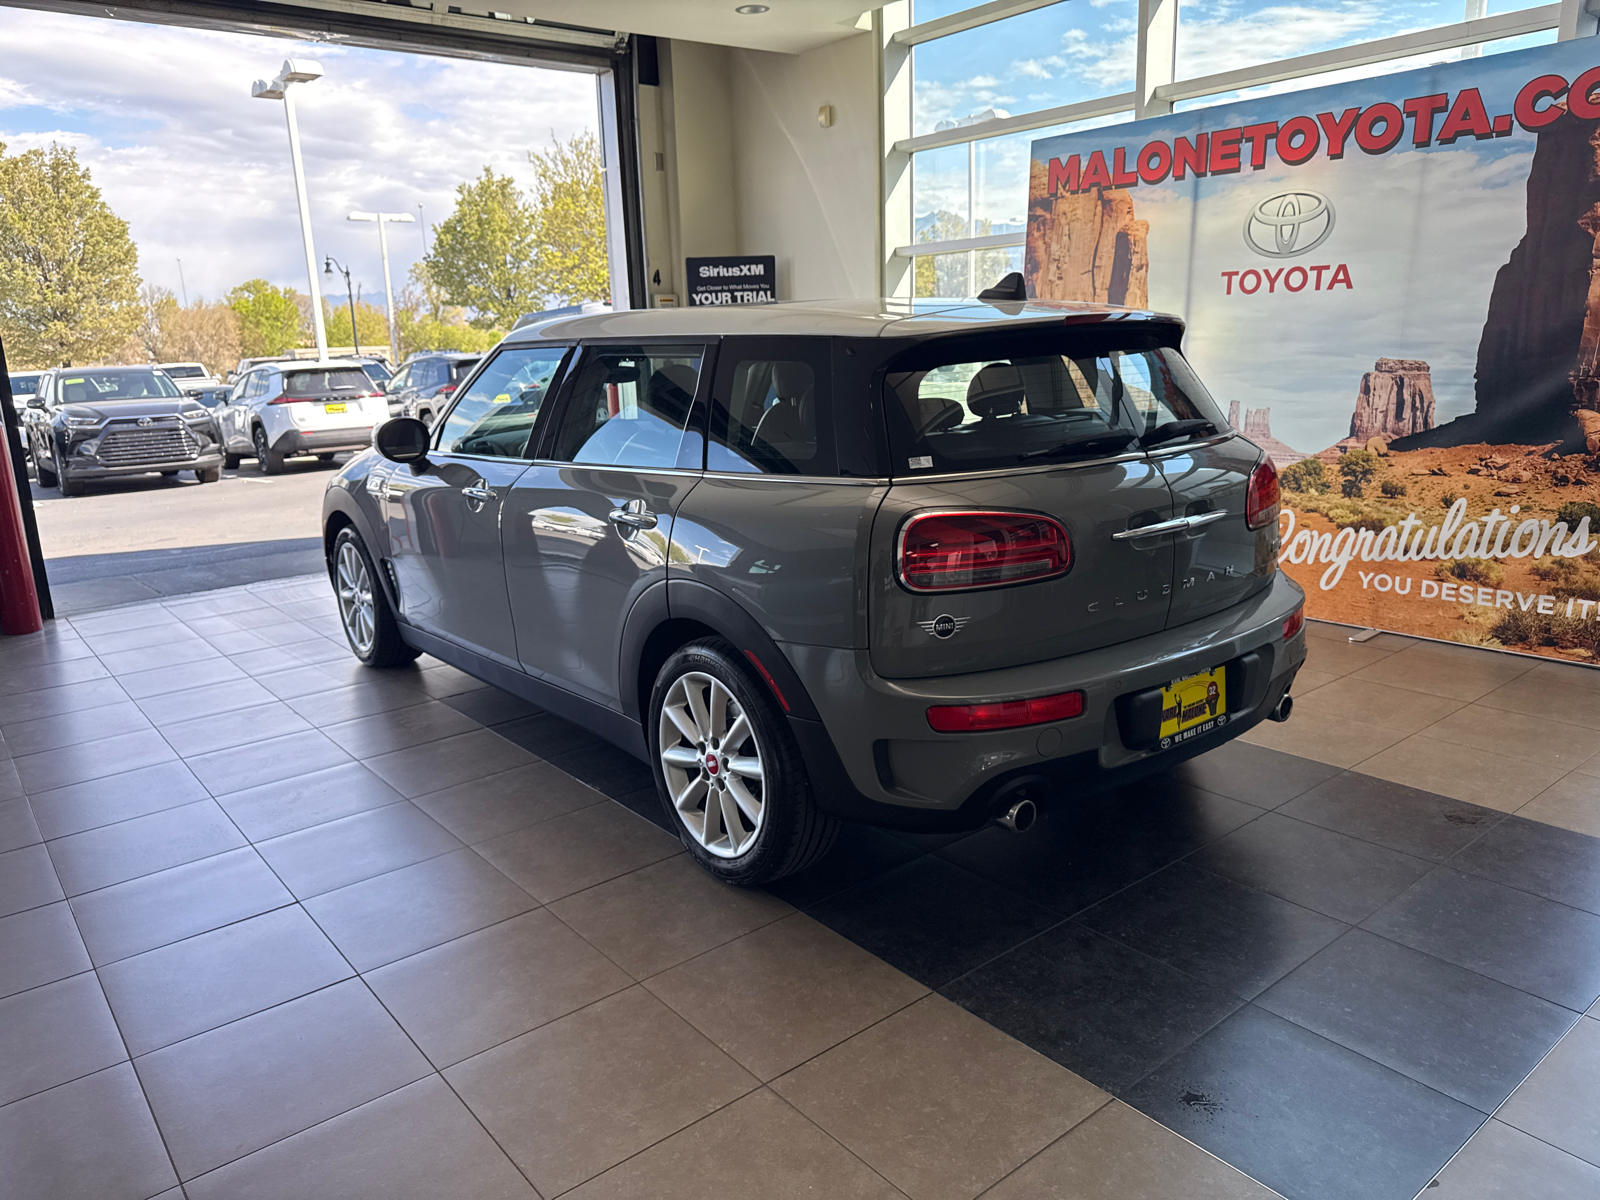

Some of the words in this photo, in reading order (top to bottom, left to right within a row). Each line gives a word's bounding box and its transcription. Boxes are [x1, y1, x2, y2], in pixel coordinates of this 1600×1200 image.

[653, 269, 661, 286] 4
[699, 264, 764, 278] SiriusXM
[1220, 264, 1354, 295] TOYOTA
[692, 291, 732, 305] YOUR
[734, 290, 775, 304] TRIAL
[1358, 571, 1412, 595] YOU
[1420, 579, 1556, 615] DESERVE
[935, 622, 954, 631] MINI
[1208, 686, 1216, 696] 32
[1174, 733, 1182, 743] WE
[1183, 728, 1196, 740] MAKE
[1202, 720, 1214, 732] EASY
